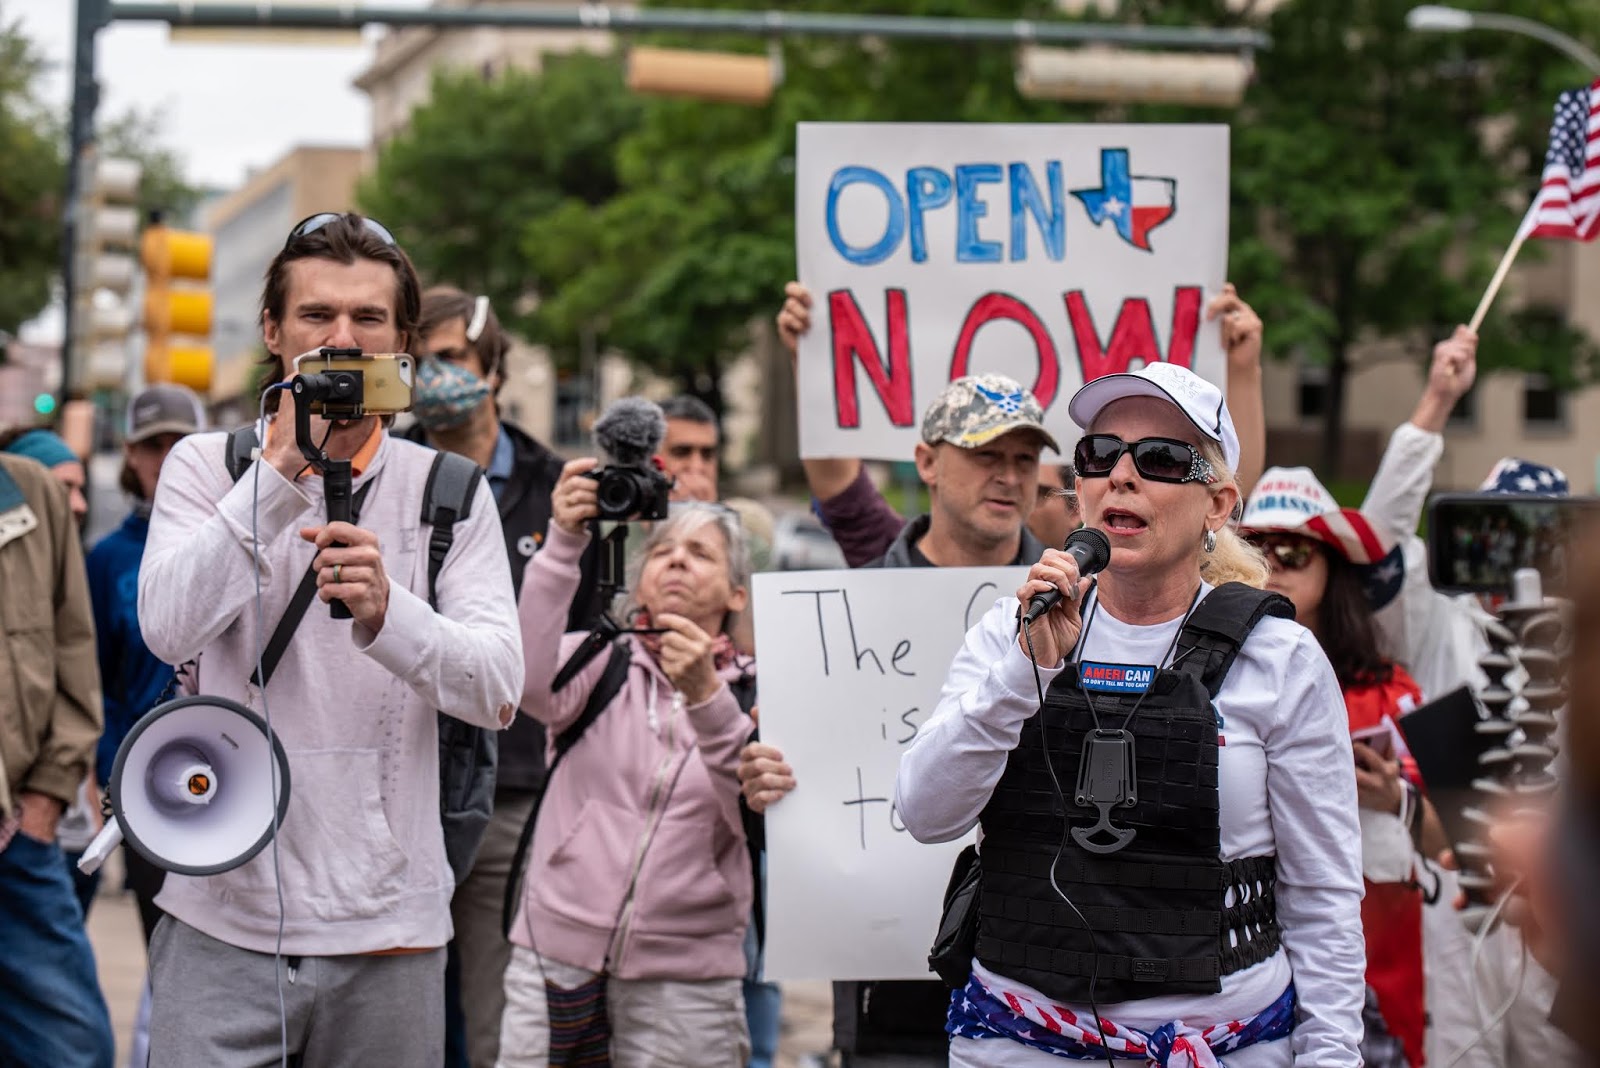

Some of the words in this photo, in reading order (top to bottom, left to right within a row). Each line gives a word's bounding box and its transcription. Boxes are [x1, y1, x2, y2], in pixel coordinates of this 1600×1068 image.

[825, 160, 1067, 266] OPEN
[828, 285, 1204, 429] NOW
[781, 588, 916, 677] The
[1083, 665, 1151, 682] AMERICAN
[881, 707, 920, 745] is
